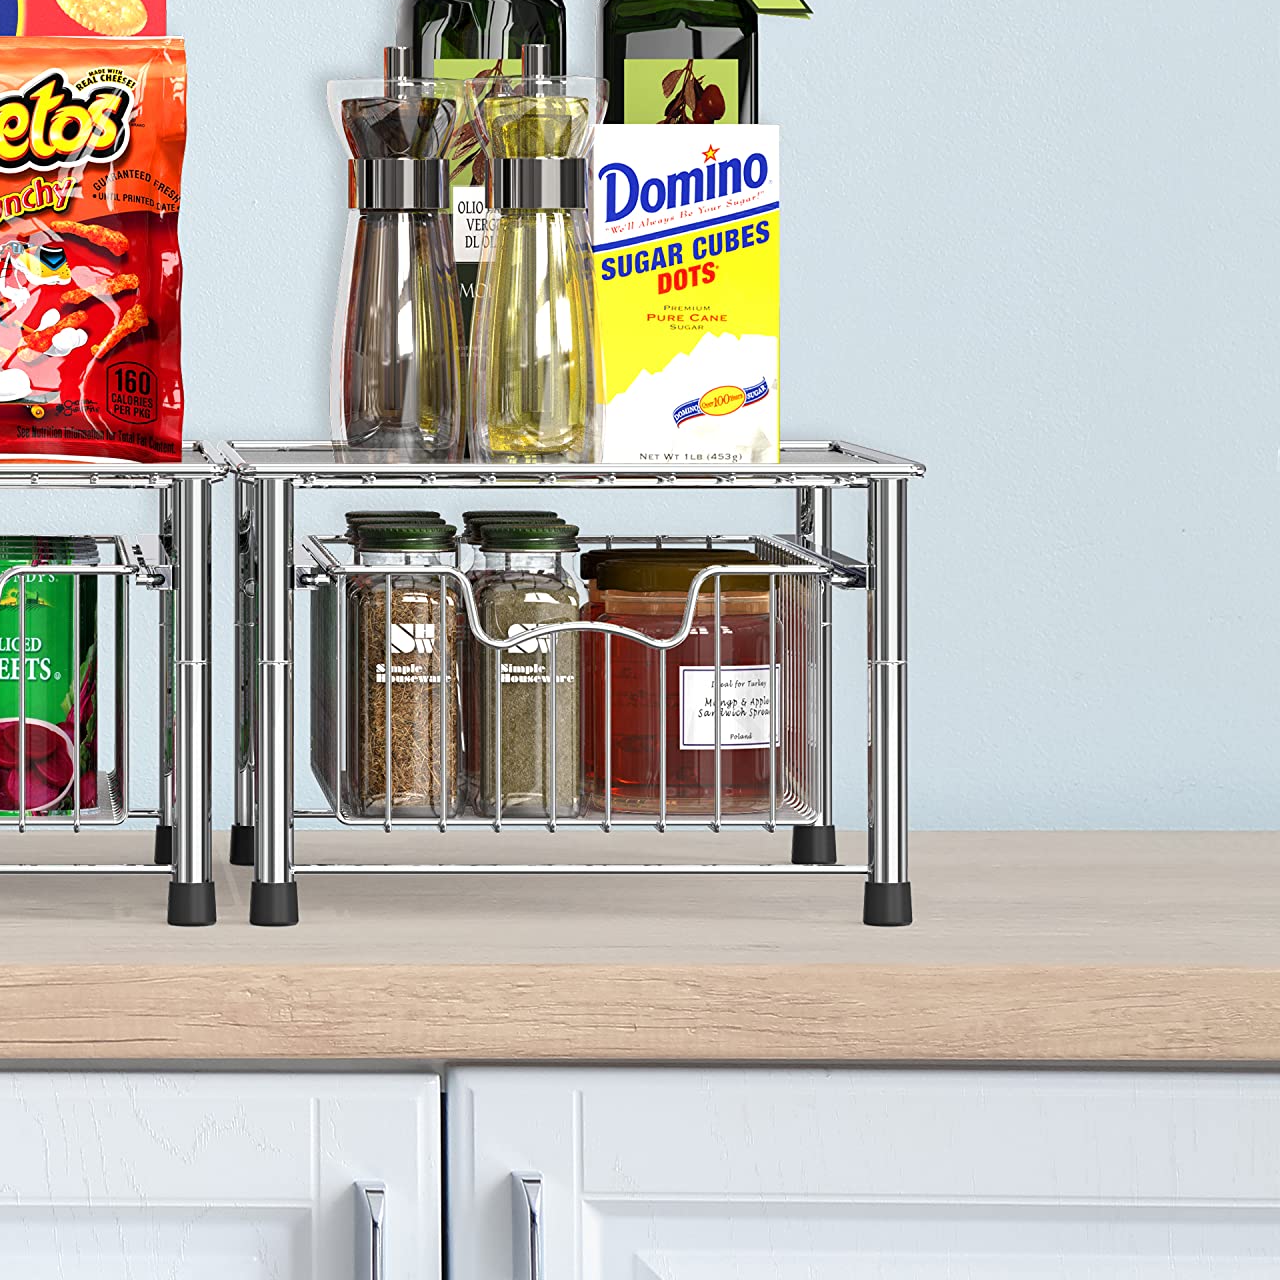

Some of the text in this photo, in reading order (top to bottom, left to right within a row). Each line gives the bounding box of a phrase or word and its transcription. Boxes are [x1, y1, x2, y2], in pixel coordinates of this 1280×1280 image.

[88, 68, 123, 77] MADE WITH
[75, 74, 137, 92] REAL CHEESE!
[93, 169, 182, 203] GUARANTEED FRESH
[598, 151, 769, 224] Domino
[122, 194, 155, 207] PRINTED
[156, 201, 176, 212] DATE
[457, 200, 484, 215] OLIO
[638, 215, 675, 229] Always
[679, 210, 693, 219] Be
[698, 204, 722, 214] Your
[601, 220, 770, 281] SUGAR CUBES
[657, 261, 717, 295] DOTS
[114, 368, 151, 396] 160
[110, 393, 154, 409] CALORIES
[713, 393, 730, 408] 100
[746, 384, 768, 400] SUGAR
[113, 403, 131, 415] PER
[133, 406, 151, 419] PKG
[16, 425, 30, 439] See
[31, 426, 63, 439] Nutrition
[64, 426, 104, 440] Information
[118, 429, 135, 444] Total
[706, 452, 743, 463] (453g)
[375, 663, 423, 675] Smple
[500, 663, 546, 675] Simple
[734, 679, 746, 689] for
[729, 732, 753, 740] Poland
